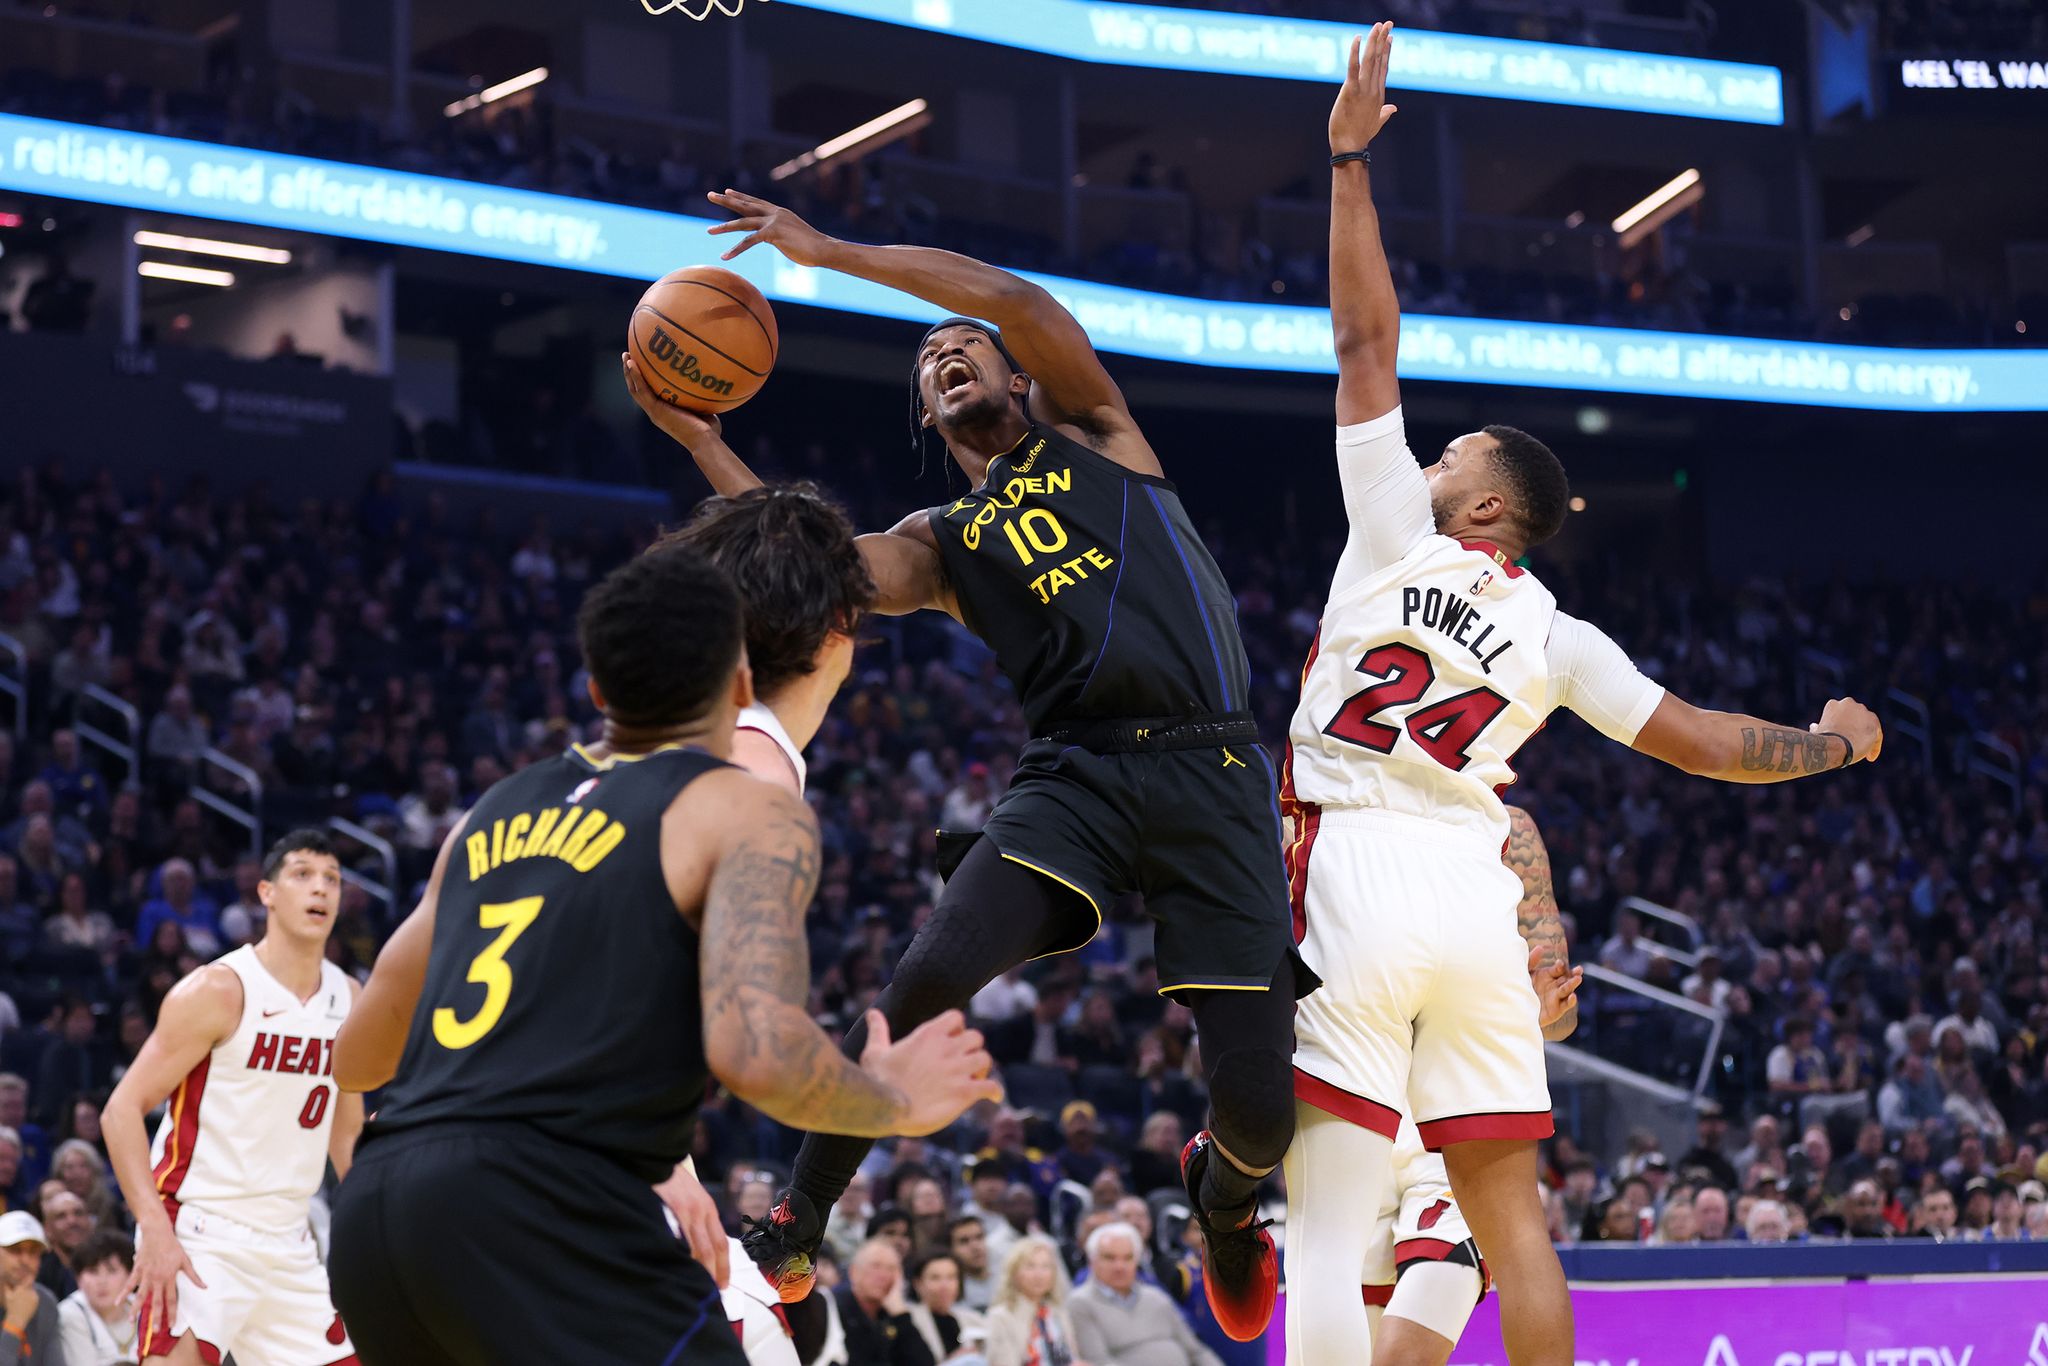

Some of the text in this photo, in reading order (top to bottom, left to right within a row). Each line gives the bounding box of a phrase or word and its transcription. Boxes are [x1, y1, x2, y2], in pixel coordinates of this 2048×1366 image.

[1088, 8, 1194, 54] We're
[1197, 24, 1337, 75] working
[1501, 51, 1580, 93] safe,
[1585, 58, 1716, 107] reliable,
[1720, 74, 1779, 109] and
[1902, 59, 2048, 88] KEL'EL WA
[13, 132, 608, 260] reliable, and affordable energy.
[648, 324, 734, 396] Wilson
[1206, 312, 1245, 350] to
[1400, 323, 1465, 369] afe,
[1471, 329, 1612, 378] reliable,
[1616, 340, 1680, 379] and
[1685, 343, 1850, 391] affordable
[1855, 362, 1980, 403] energy.
[963, 468, 1071, 550] GOLDEN
[1003, 508, 1068, 566] 10
[1403, 587, 1513, 674] POWELL
[1322, 641, 1511, 772] 24
[466, 806, 626, 881] RICHARD
[432, 895, 545, 1050] 3
[298, 1084, 330, 1129] 0
